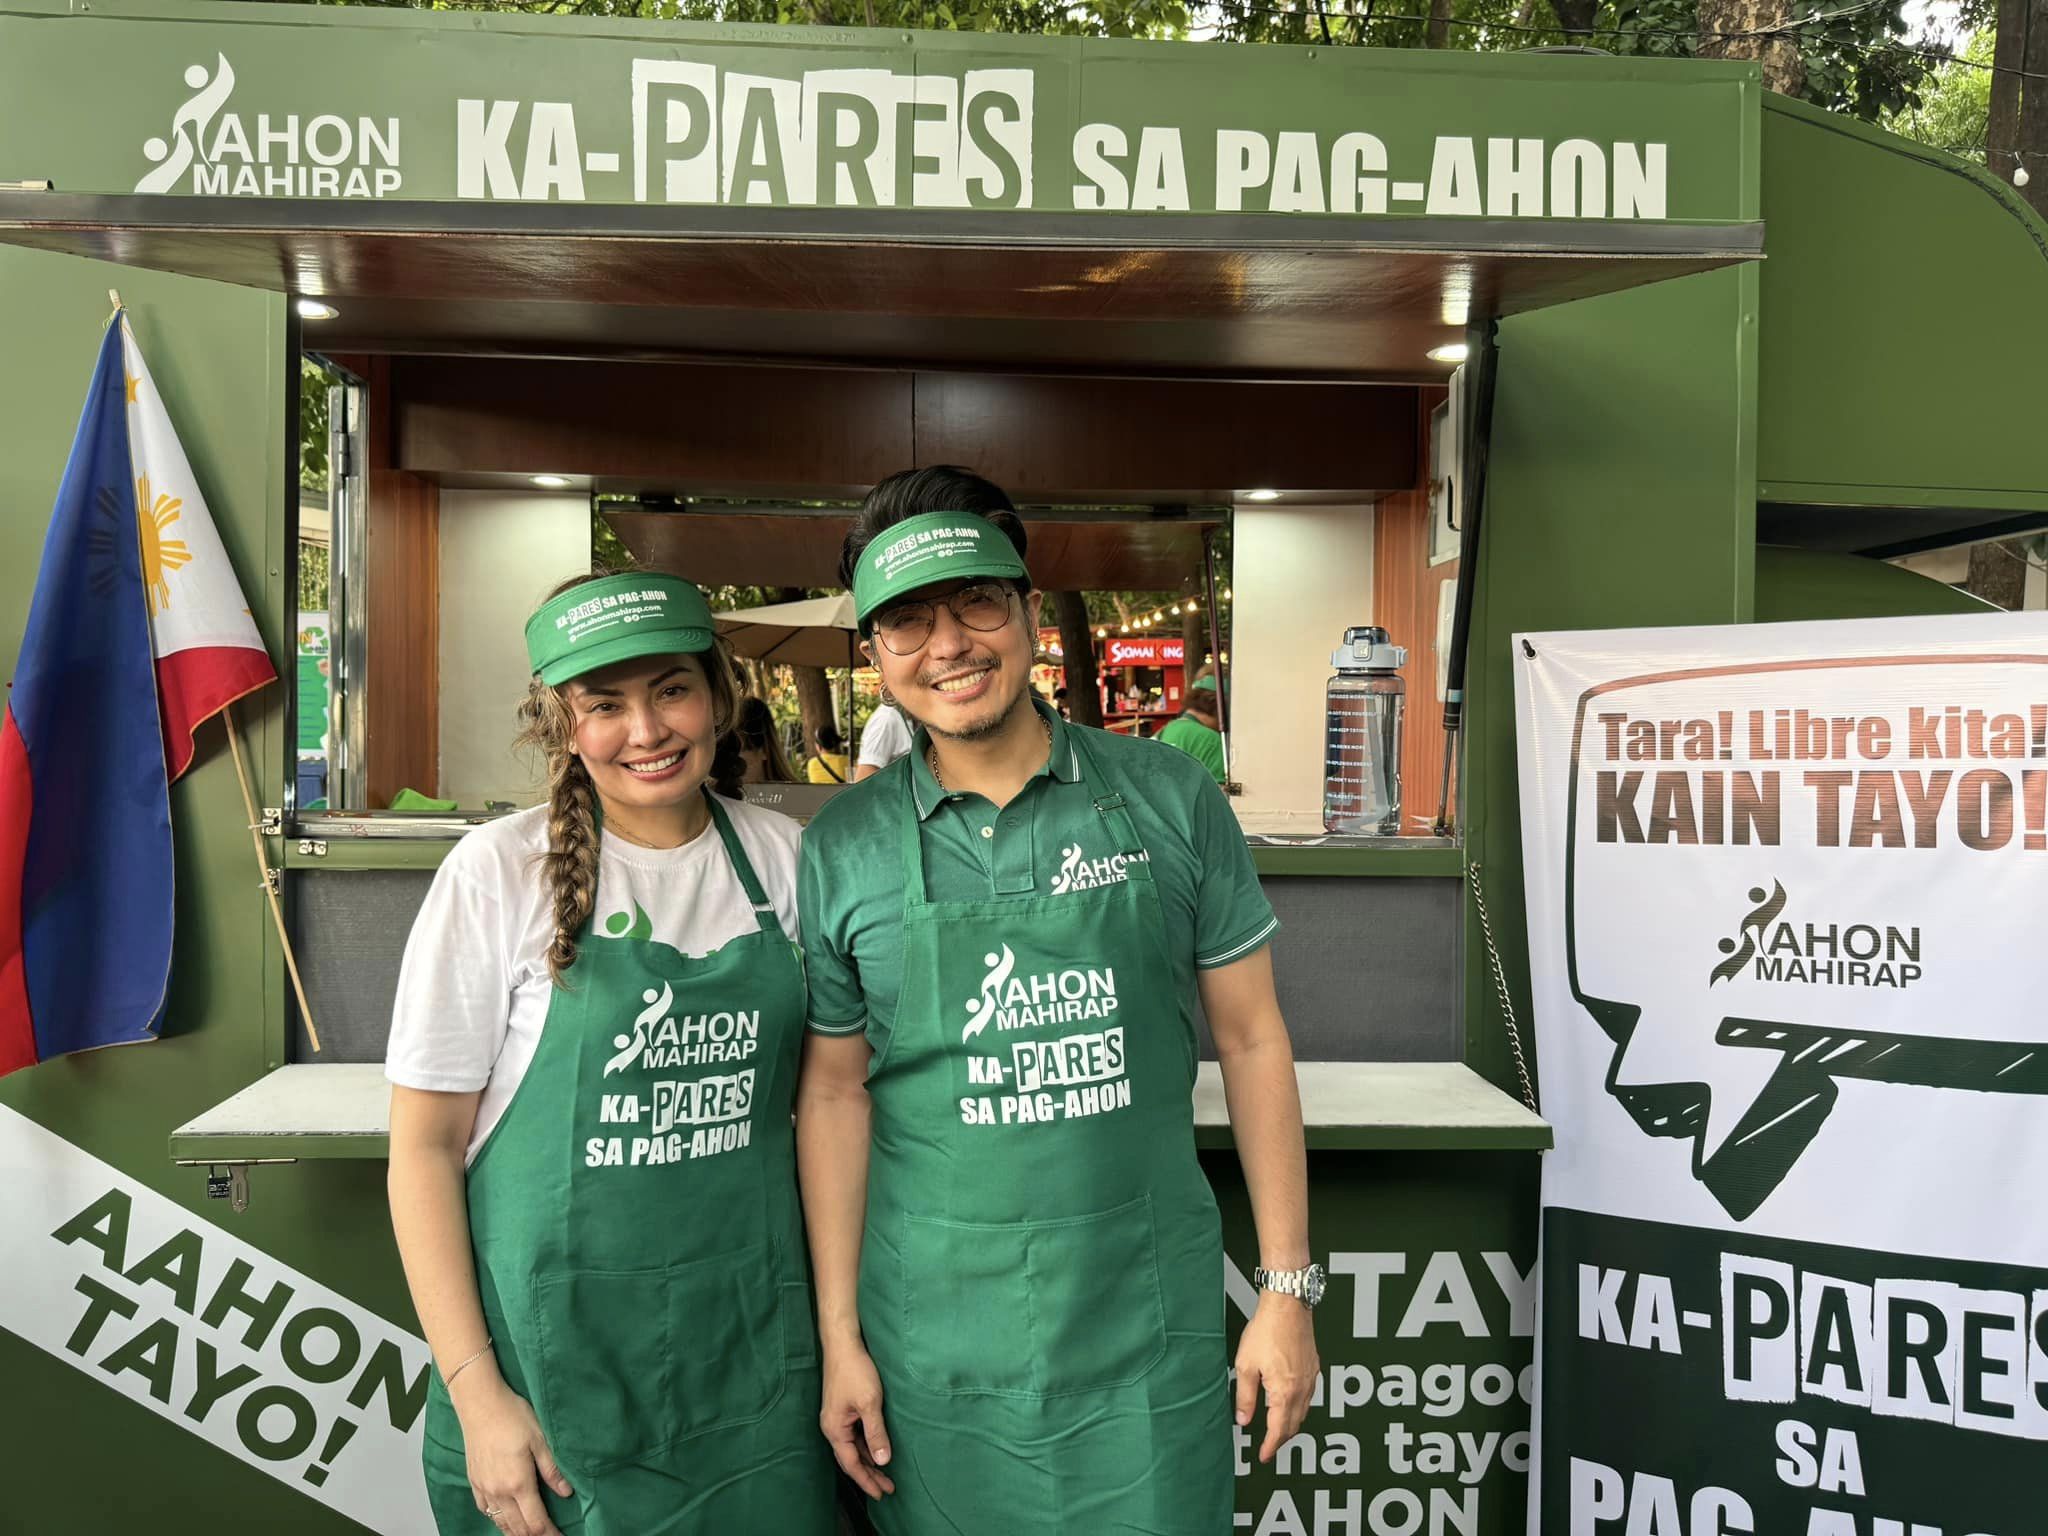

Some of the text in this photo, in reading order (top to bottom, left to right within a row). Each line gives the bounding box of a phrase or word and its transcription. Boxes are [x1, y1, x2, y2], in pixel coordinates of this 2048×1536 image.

[208, 114, 400, 168] AHON
[457, 59, 1668, 219] KA-PARES SA PAG-AHON
[193, 164, 402, 198] MAHIRAP
[916, 531, 932, 544] SA
[601, 595, 618, 608] SA
[617, 590, 667, 605] PAG-AHON
[1111, 642, 1154, 663] SIOMAI
[1598, 703, 2048, 762] Tara! Libre kita!
[1596, 768, 2048, 851] KAIN TAYO!
[1767, 923, 1921, 962] AHON
[1004, 968, 1116, 1008] AHON
[1755, 956, 1922, 988] MAHIRAP
[654, 1010, 760, 1047] AHON
[995, 996, 1119, 1032] MAHIRAP
[642, 1039, 758, 1069] MAHIRAP
[967, 1026, 1125, 1093] KA-PARES
[600, 1068, 756, 1135] KA-PARES
[960, 1078, 1132, 1125] SA PAG-AHON
[585, 1120, 752, 1168] SA PAG-AHON
[50, 1187, 433, 1434] AAHON
[1328, 1250, 1537, 1338] TAY
[65, 1273, 359, 1488] TAYO!
[1775, 1419, 1866, 1496] SA
[1233, 1487, 1479, 1536] -AHON
